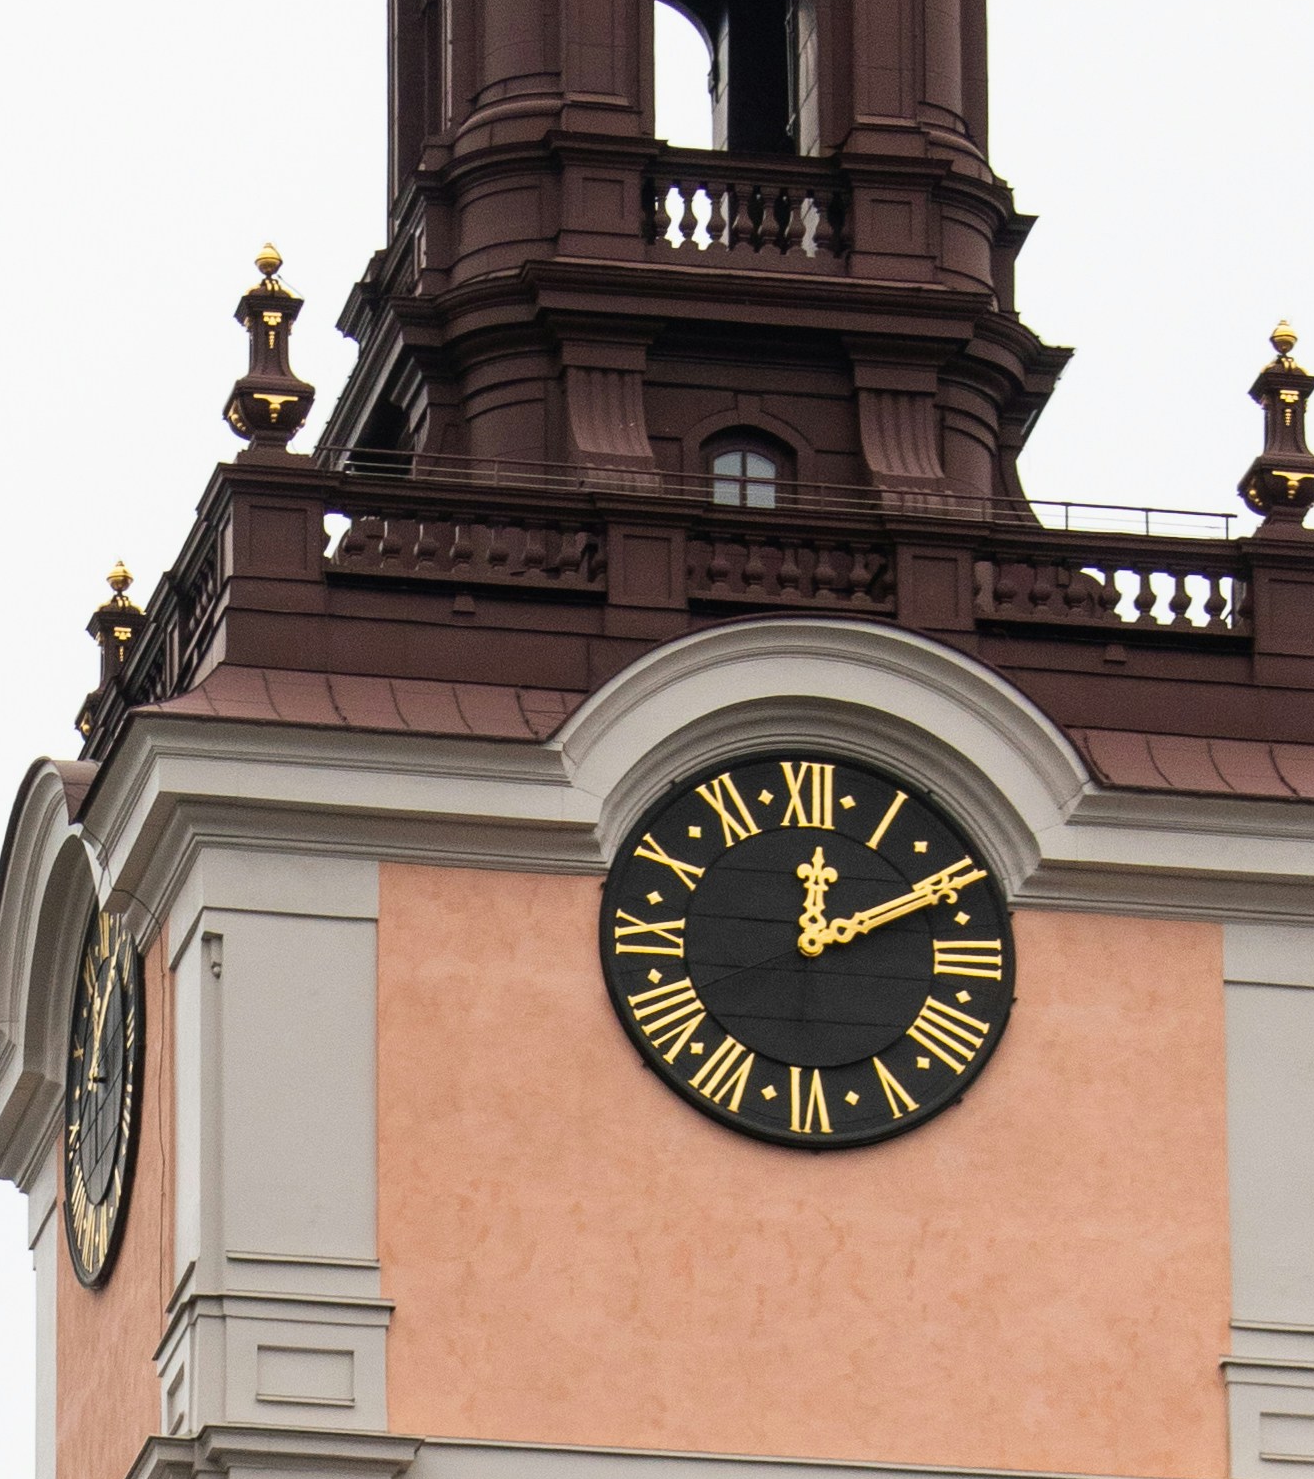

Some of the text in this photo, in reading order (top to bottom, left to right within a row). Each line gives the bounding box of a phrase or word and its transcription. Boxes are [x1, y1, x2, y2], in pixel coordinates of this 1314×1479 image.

[695, 773, 762, 848] XI
[780, 761, 835, 830] XII
[866, 790, 908, 850] I
[634, 833, 705, 891] X
[614, 909, 686, 958] IX
[932, 938, 1003, 981] III
[628, 977, 706, 1065] VIII
[905, 996, 991, 1075] IIII
[688, 1035, 755, 1114] VII
[789, 1066, 834, 1134] VI
[872, 1056, 920, 1119] V
